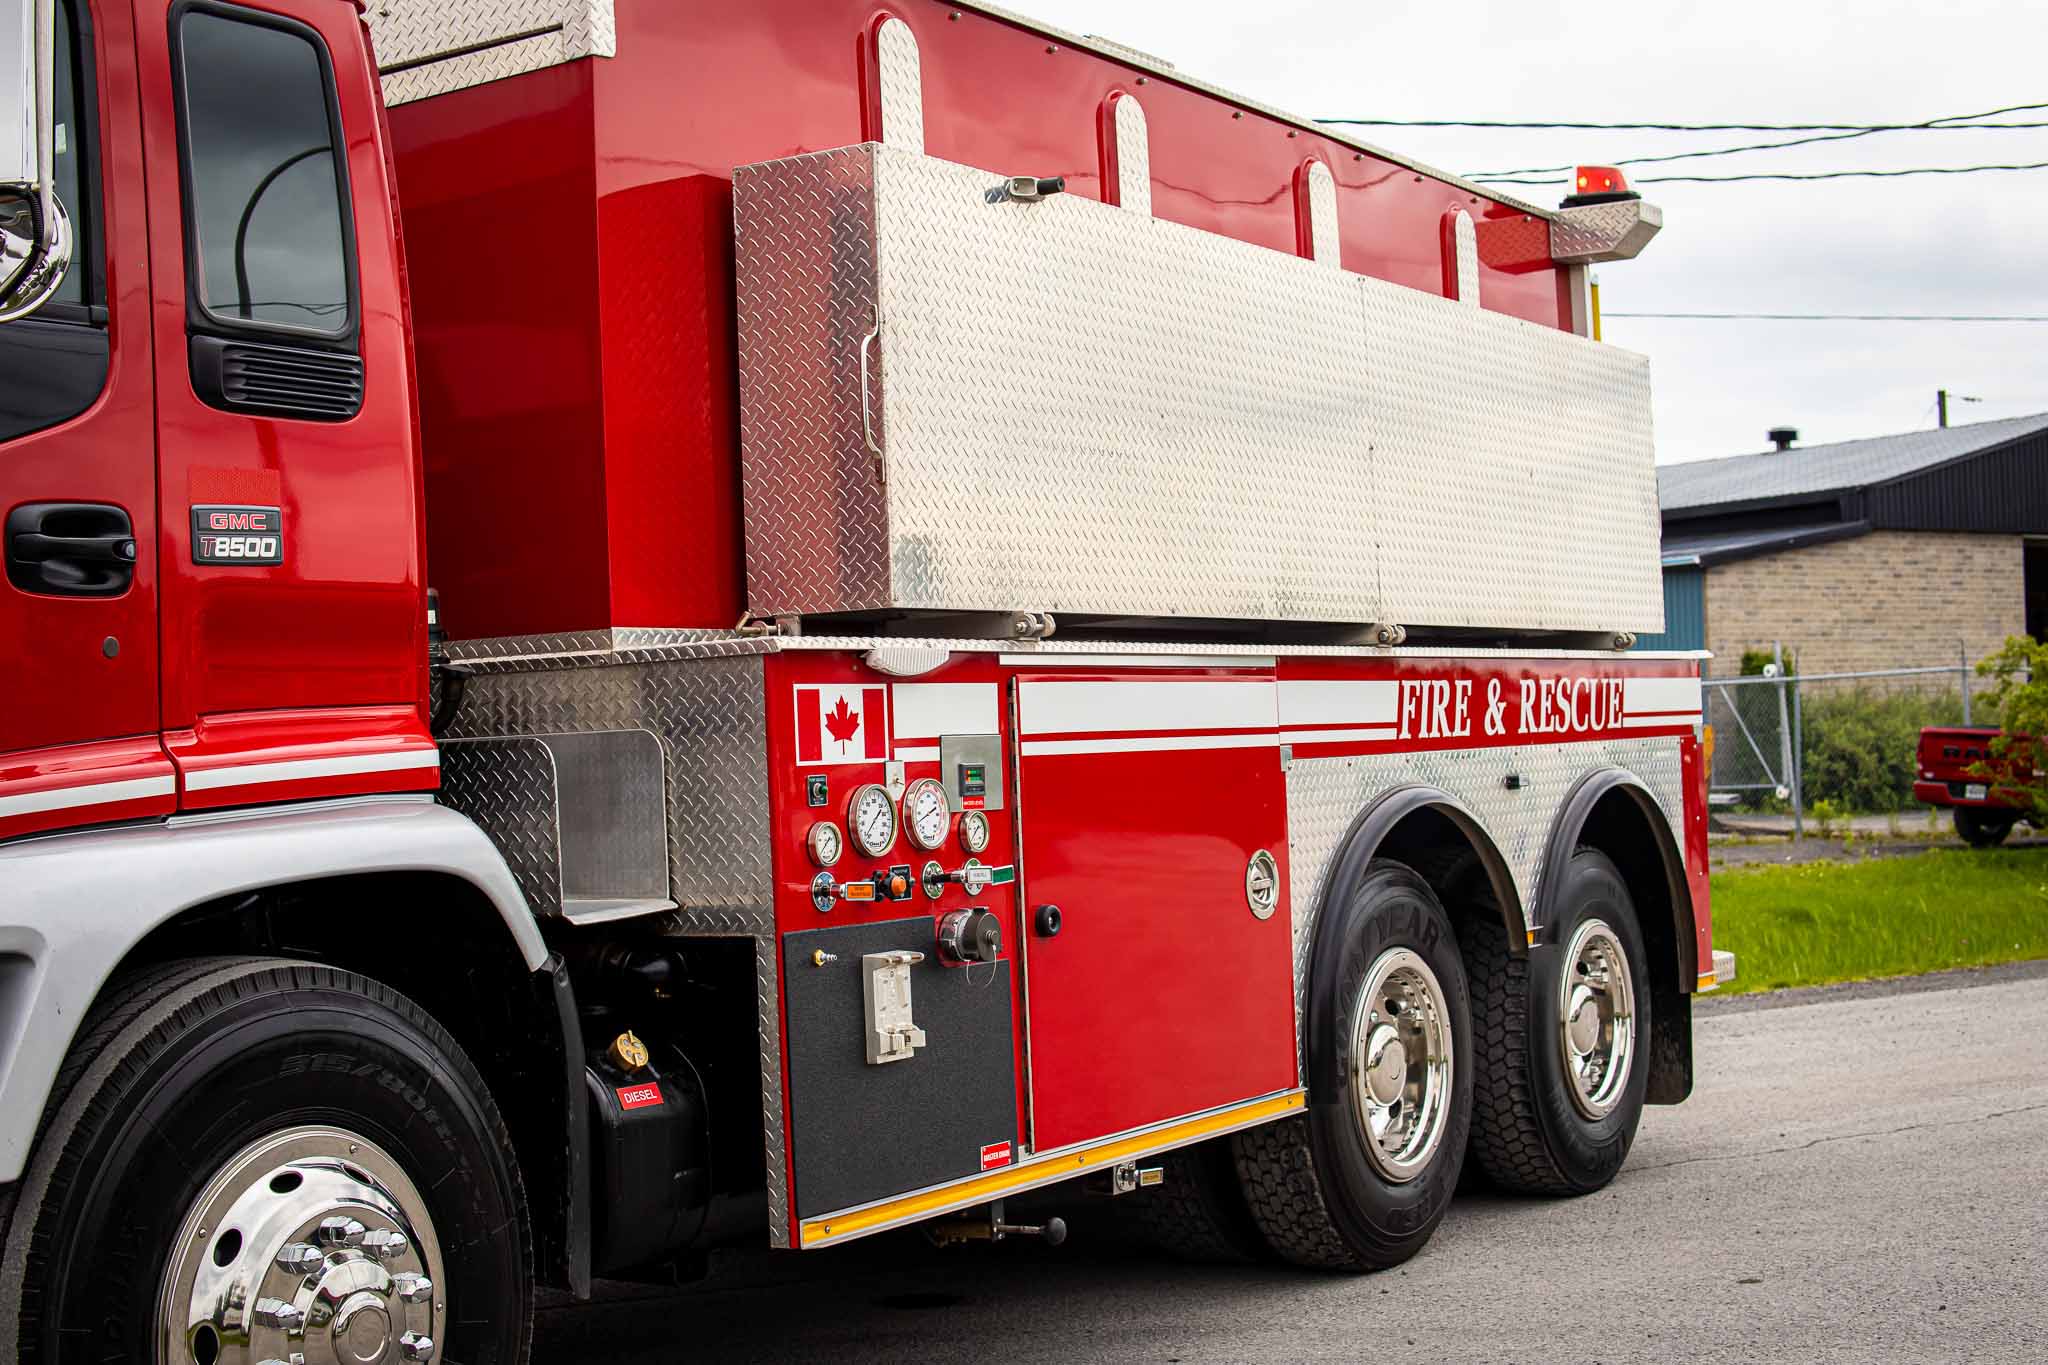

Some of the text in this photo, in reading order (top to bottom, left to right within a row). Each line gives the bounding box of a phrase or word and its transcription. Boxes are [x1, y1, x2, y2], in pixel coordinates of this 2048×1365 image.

[210, 513, 266, 530] GMC
[201, 537, 277, 557] T8500
[1399, 677, 1623, 740] FIRE & RESCUE
[624, 1089, 658, 1104] DIESEL
